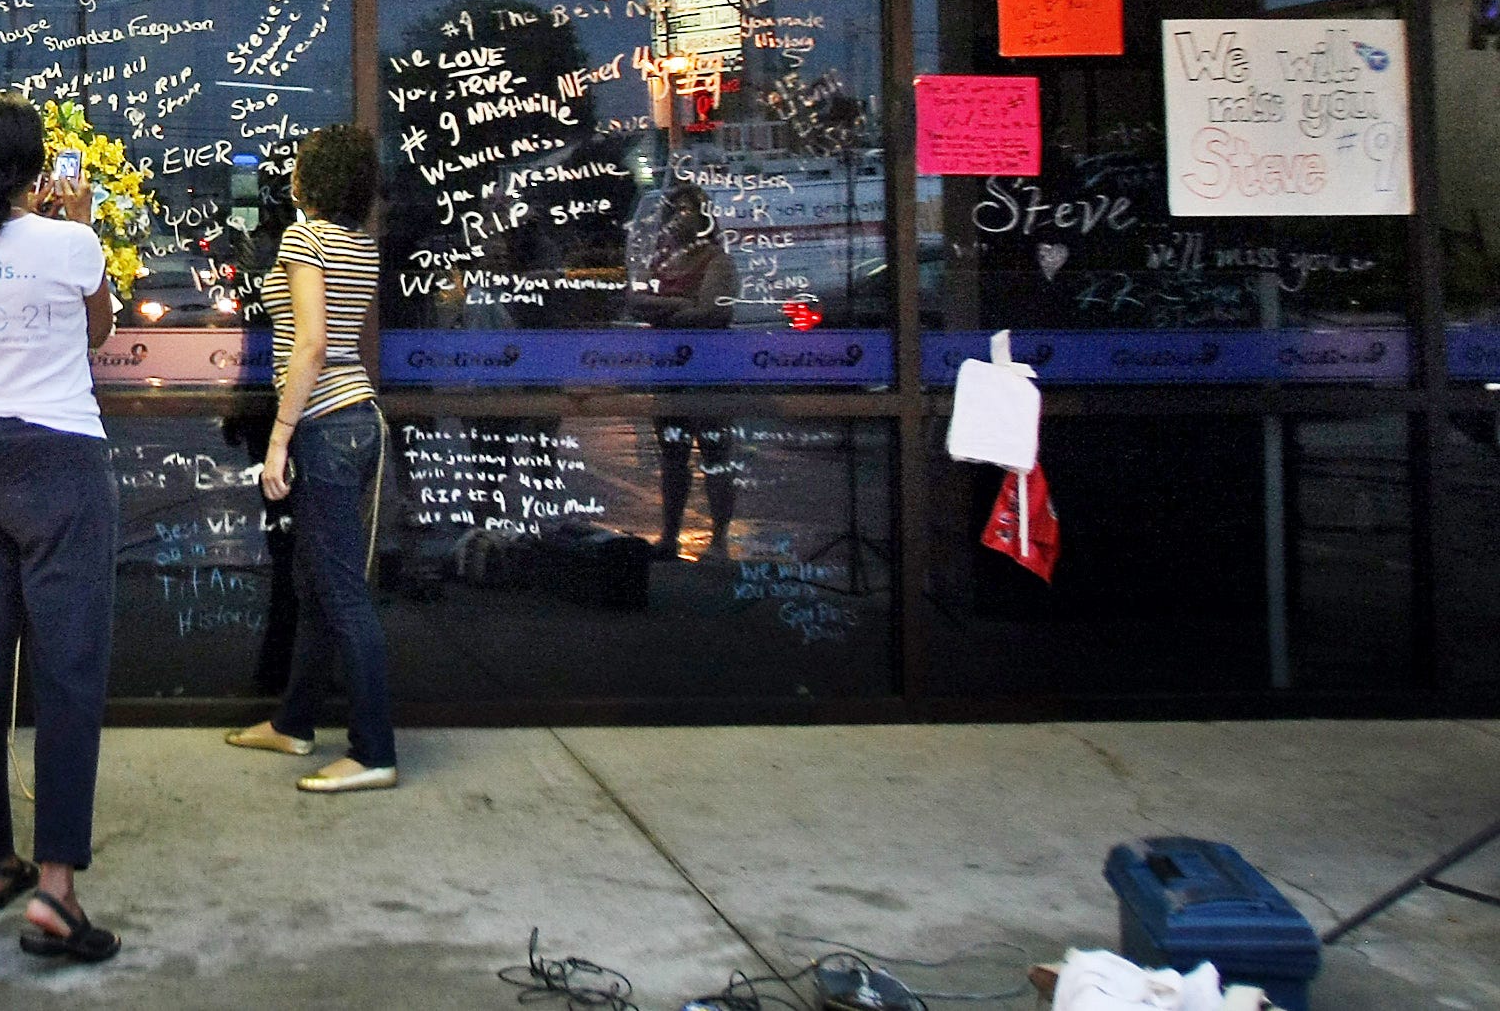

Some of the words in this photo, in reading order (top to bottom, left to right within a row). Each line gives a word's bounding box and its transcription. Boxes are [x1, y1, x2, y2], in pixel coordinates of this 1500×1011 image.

[438, 47, 507, 72] LOVE
[1174, 29, 1250, 84] We
[162, 140, 234, 175] EVER
[1180, 126, 1329, 200] Steve
[971, 175, 1140, 235] Steve
